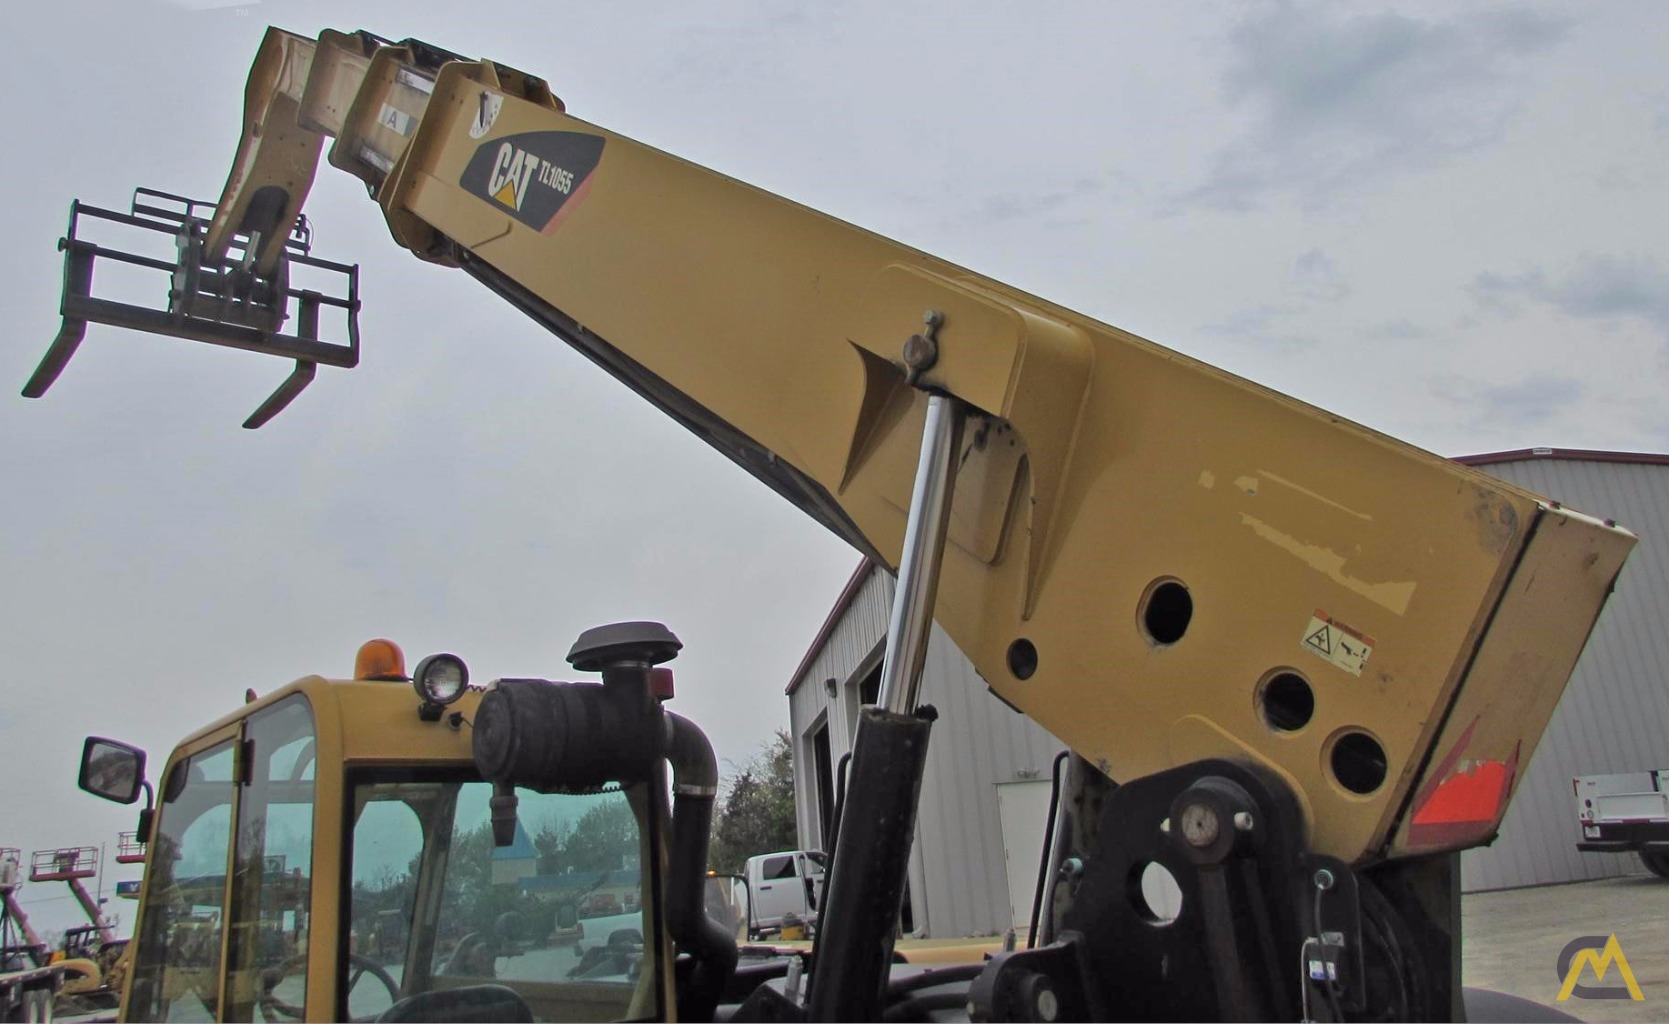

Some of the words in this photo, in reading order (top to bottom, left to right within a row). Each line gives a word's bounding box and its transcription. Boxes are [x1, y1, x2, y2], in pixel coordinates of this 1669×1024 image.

[386, 110, 398, 129] A
[488, 142, 540, 212] CAT
[538, 160, 574, 195] TL1055
